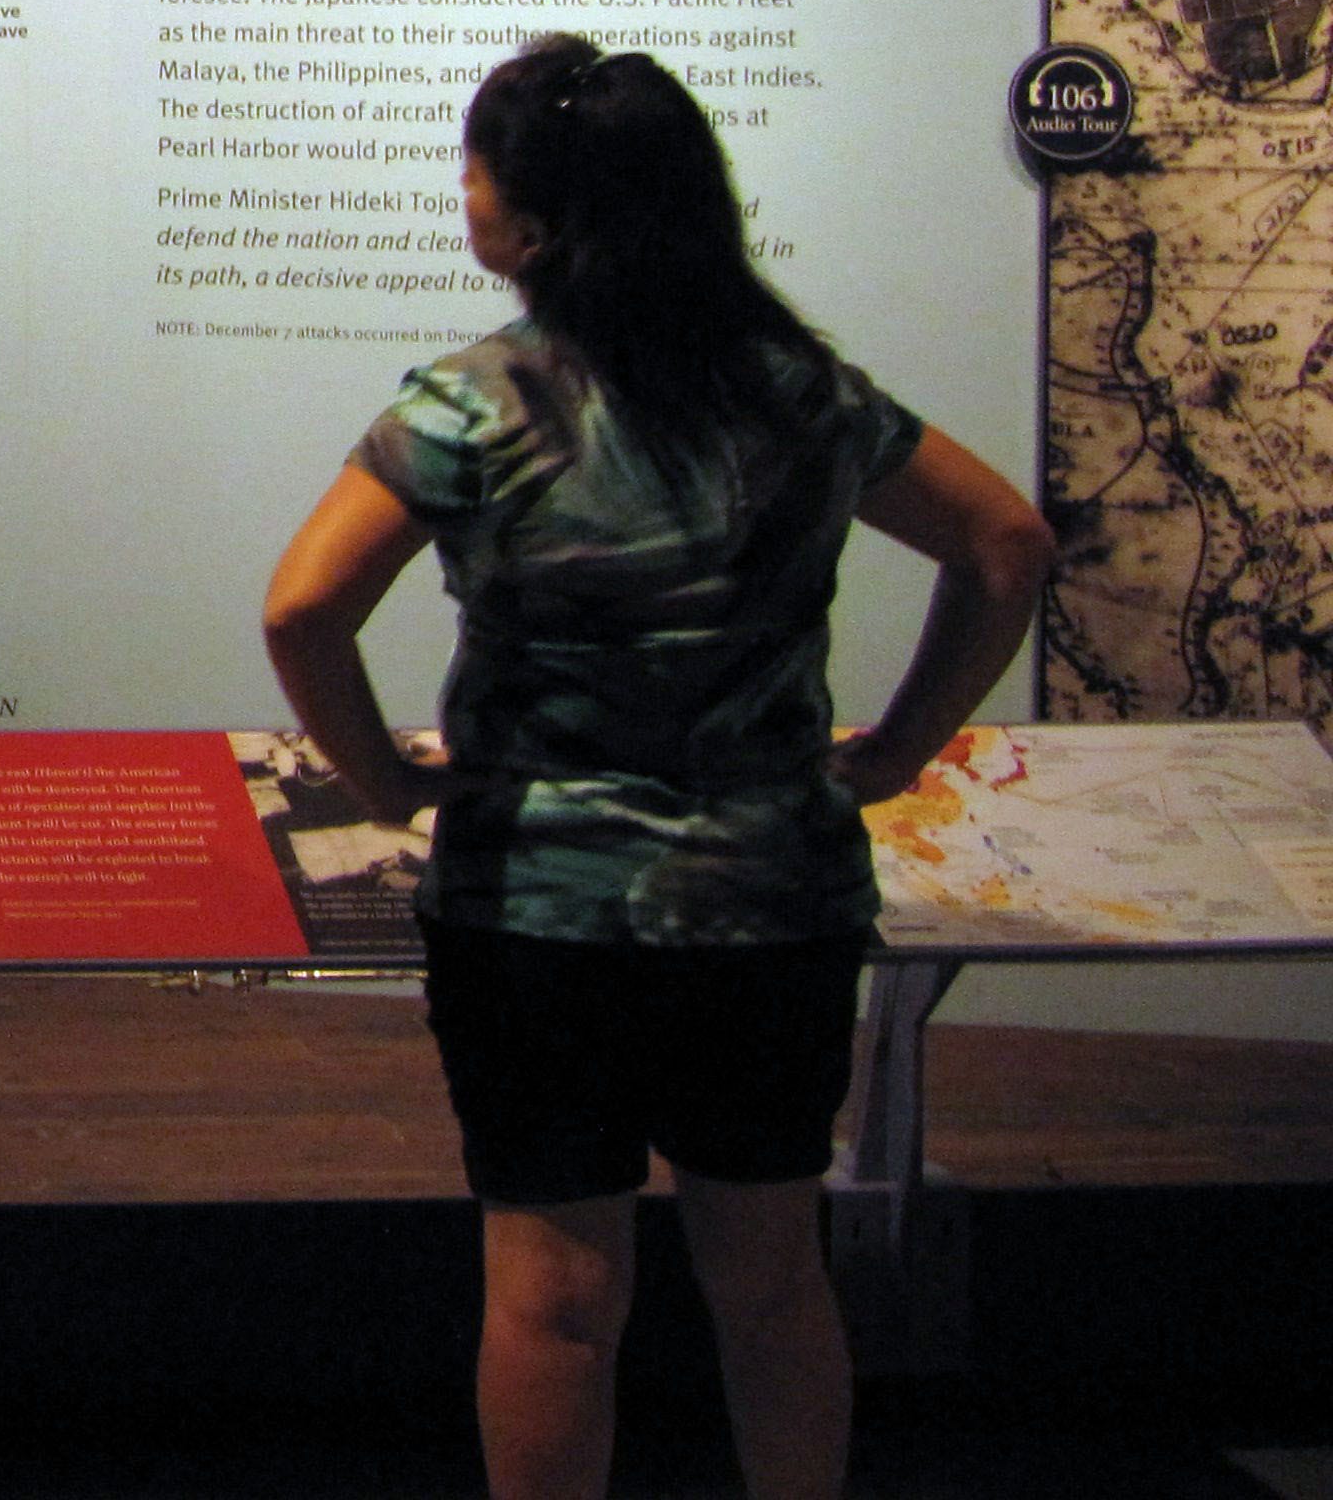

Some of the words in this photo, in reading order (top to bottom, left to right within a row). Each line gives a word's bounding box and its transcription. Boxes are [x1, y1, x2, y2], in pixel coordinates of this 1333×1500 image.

[1049, 84, 1098, 111] 106
[1026, 116, 1075, 132] Audio
[1082, 117, 1119, 132] Tour
